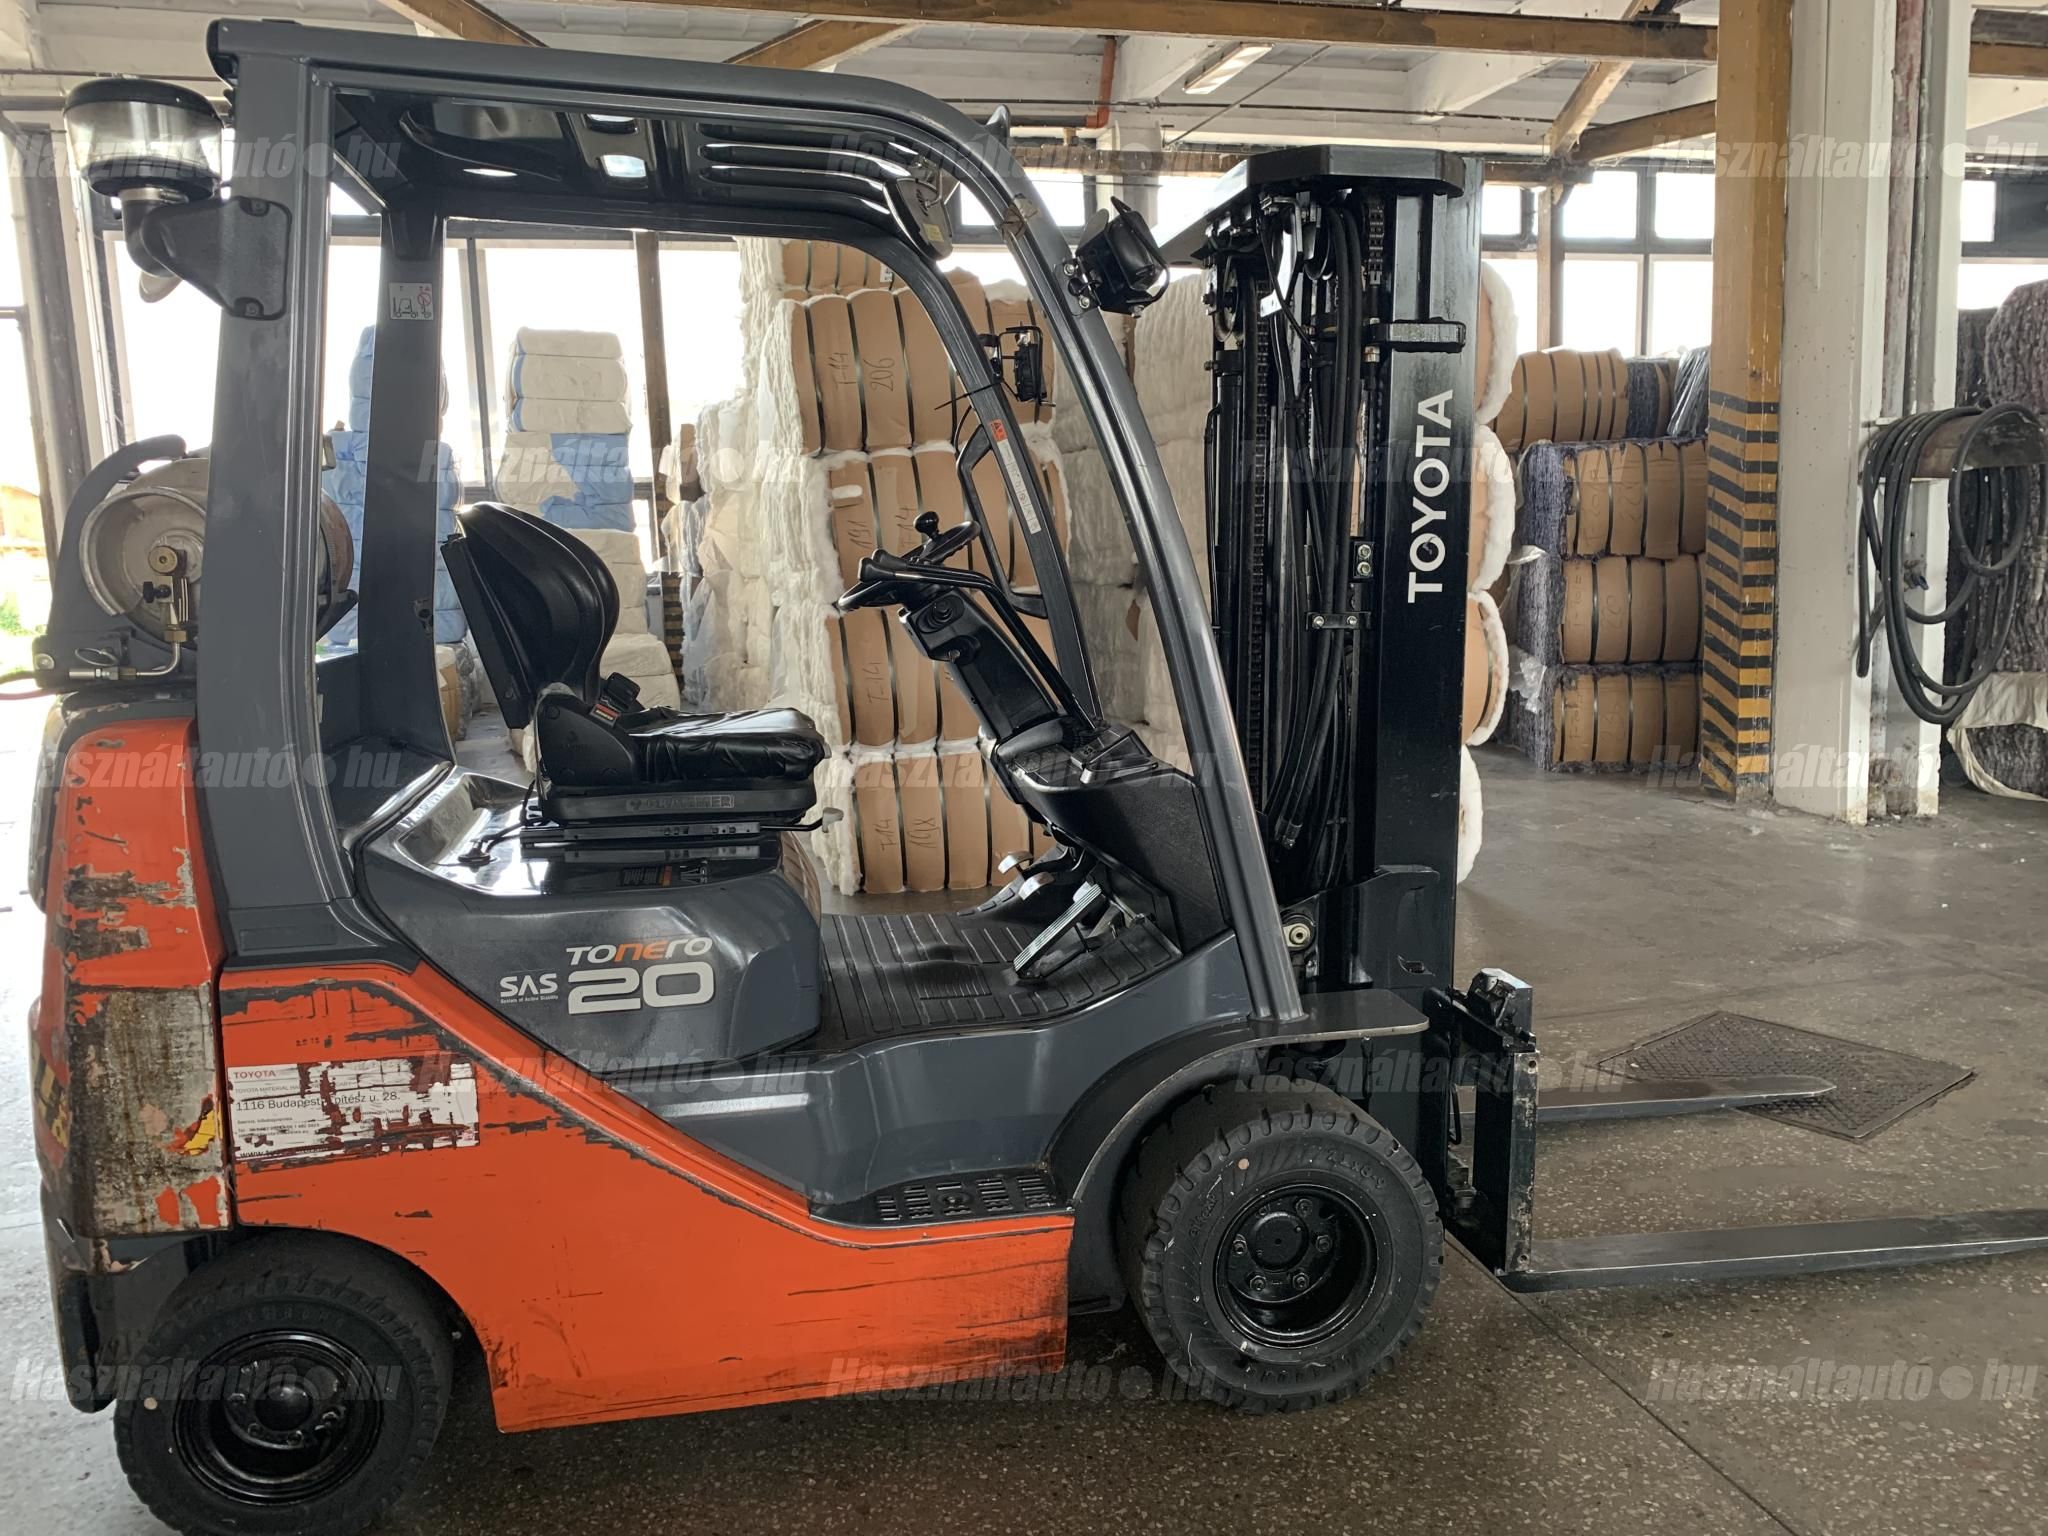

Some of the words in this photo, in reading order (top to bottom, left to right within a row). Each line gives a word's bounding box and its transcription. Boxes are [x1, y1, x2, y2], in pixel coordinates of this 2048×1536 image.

[863, 357, 895, 391] 206
[1408, 389, 1453, 604] TOYOTA
[500, 972, 558, 998] SAS
[567, 961, 714, 1015] 20
[234, 1069, 277, 1080] TOYOTA
[236, 1100, 265, 1112] 1116
[369, 1093, 380, 1103] u.
[382, 1090, 401, 1102] 28.
